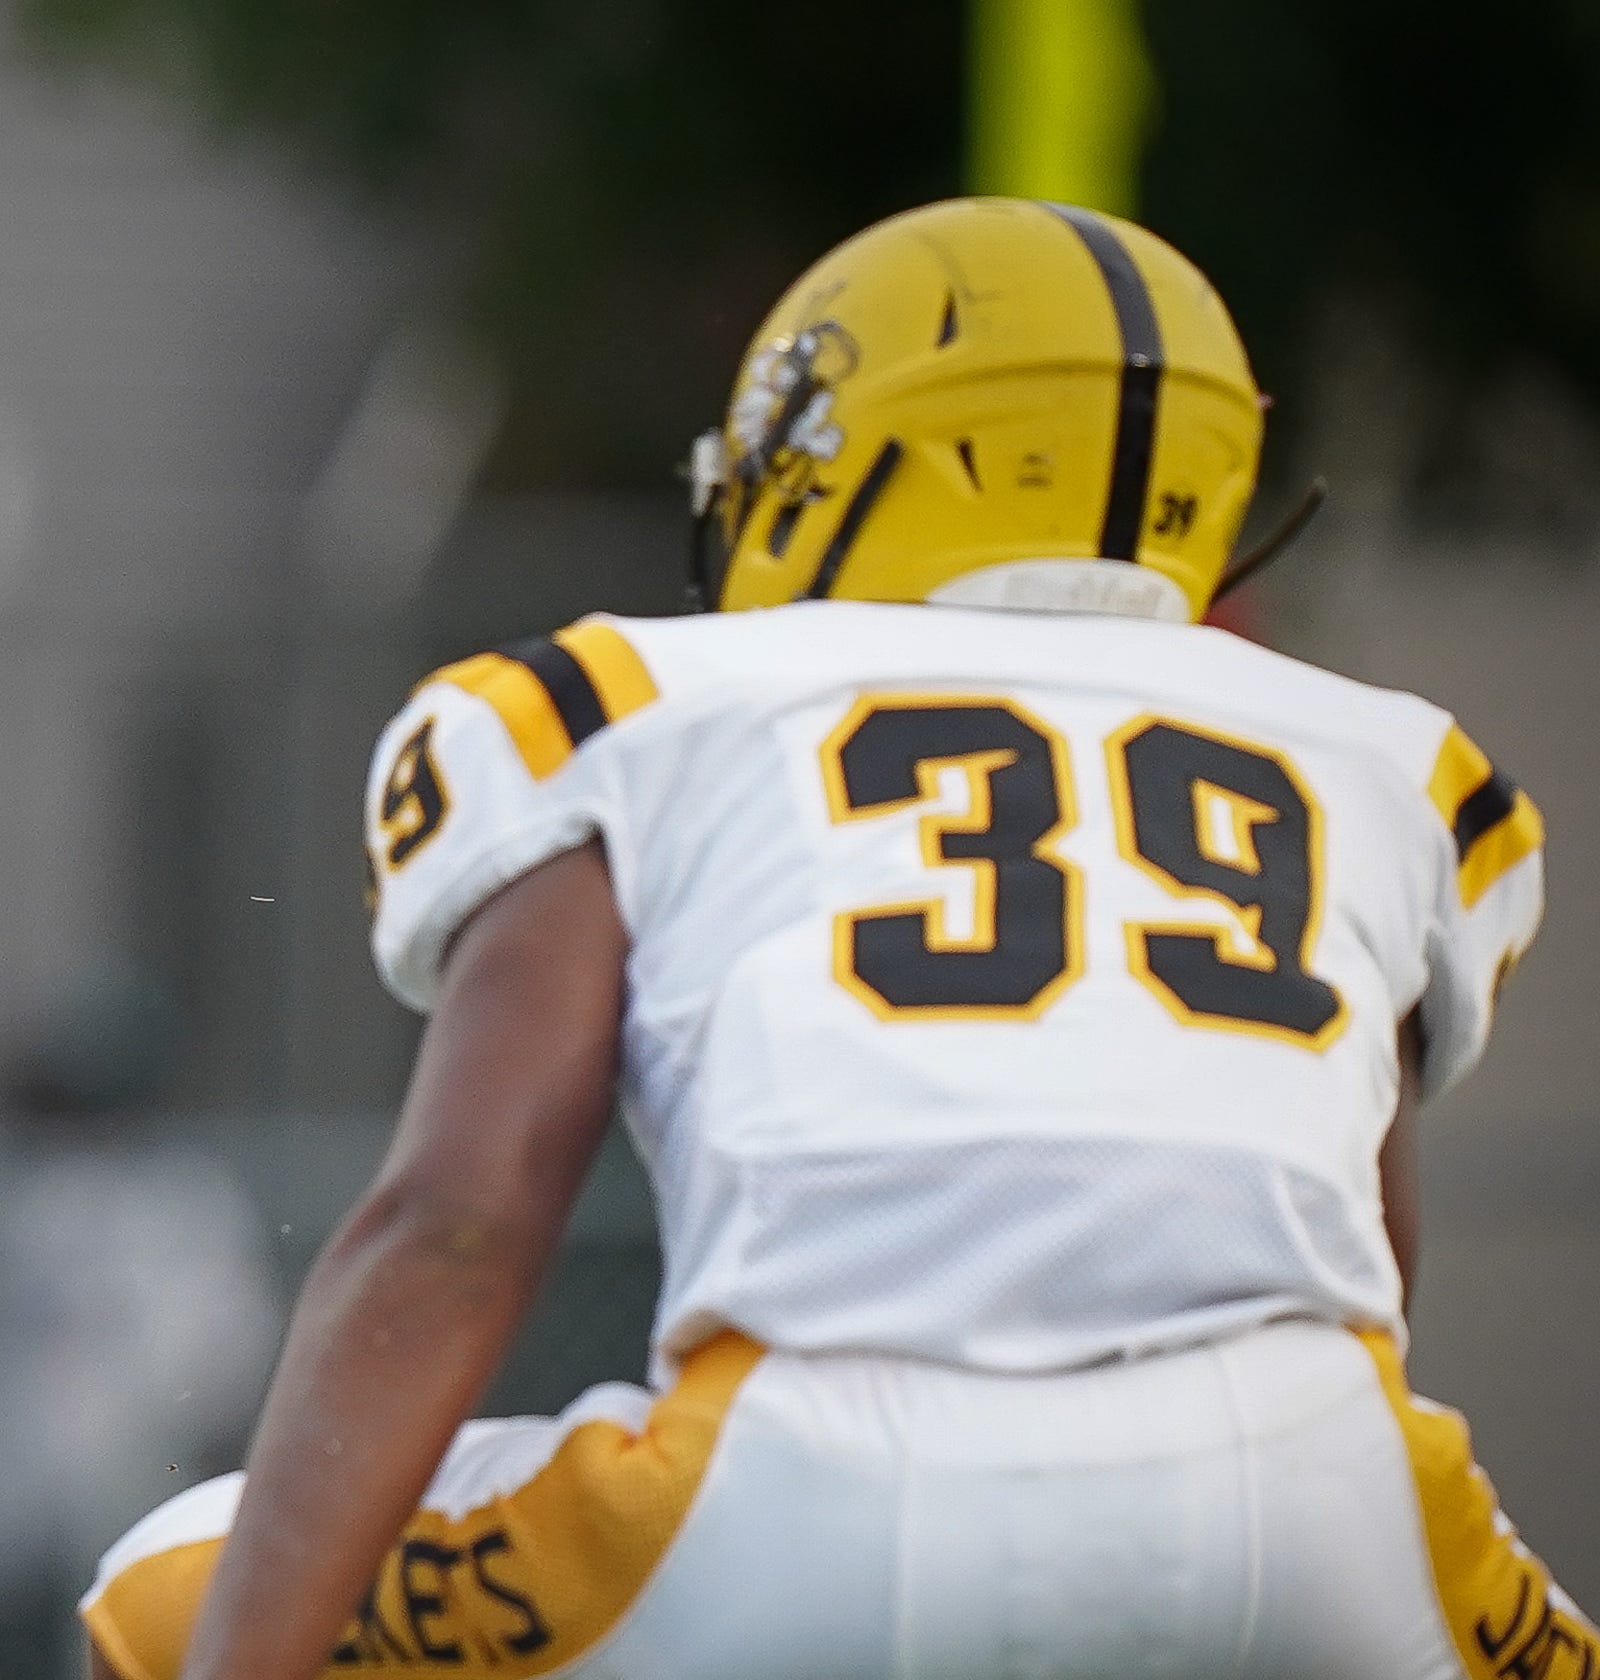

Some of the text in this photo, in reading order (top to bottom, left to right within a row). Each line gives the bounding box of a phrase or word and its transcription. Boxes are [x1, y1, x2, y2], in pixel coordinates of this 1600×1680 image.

[1154, 492, 1198, 537] 39
[363, 714, 451, 918] 9
[819, 692, 1351, 1054] 39
